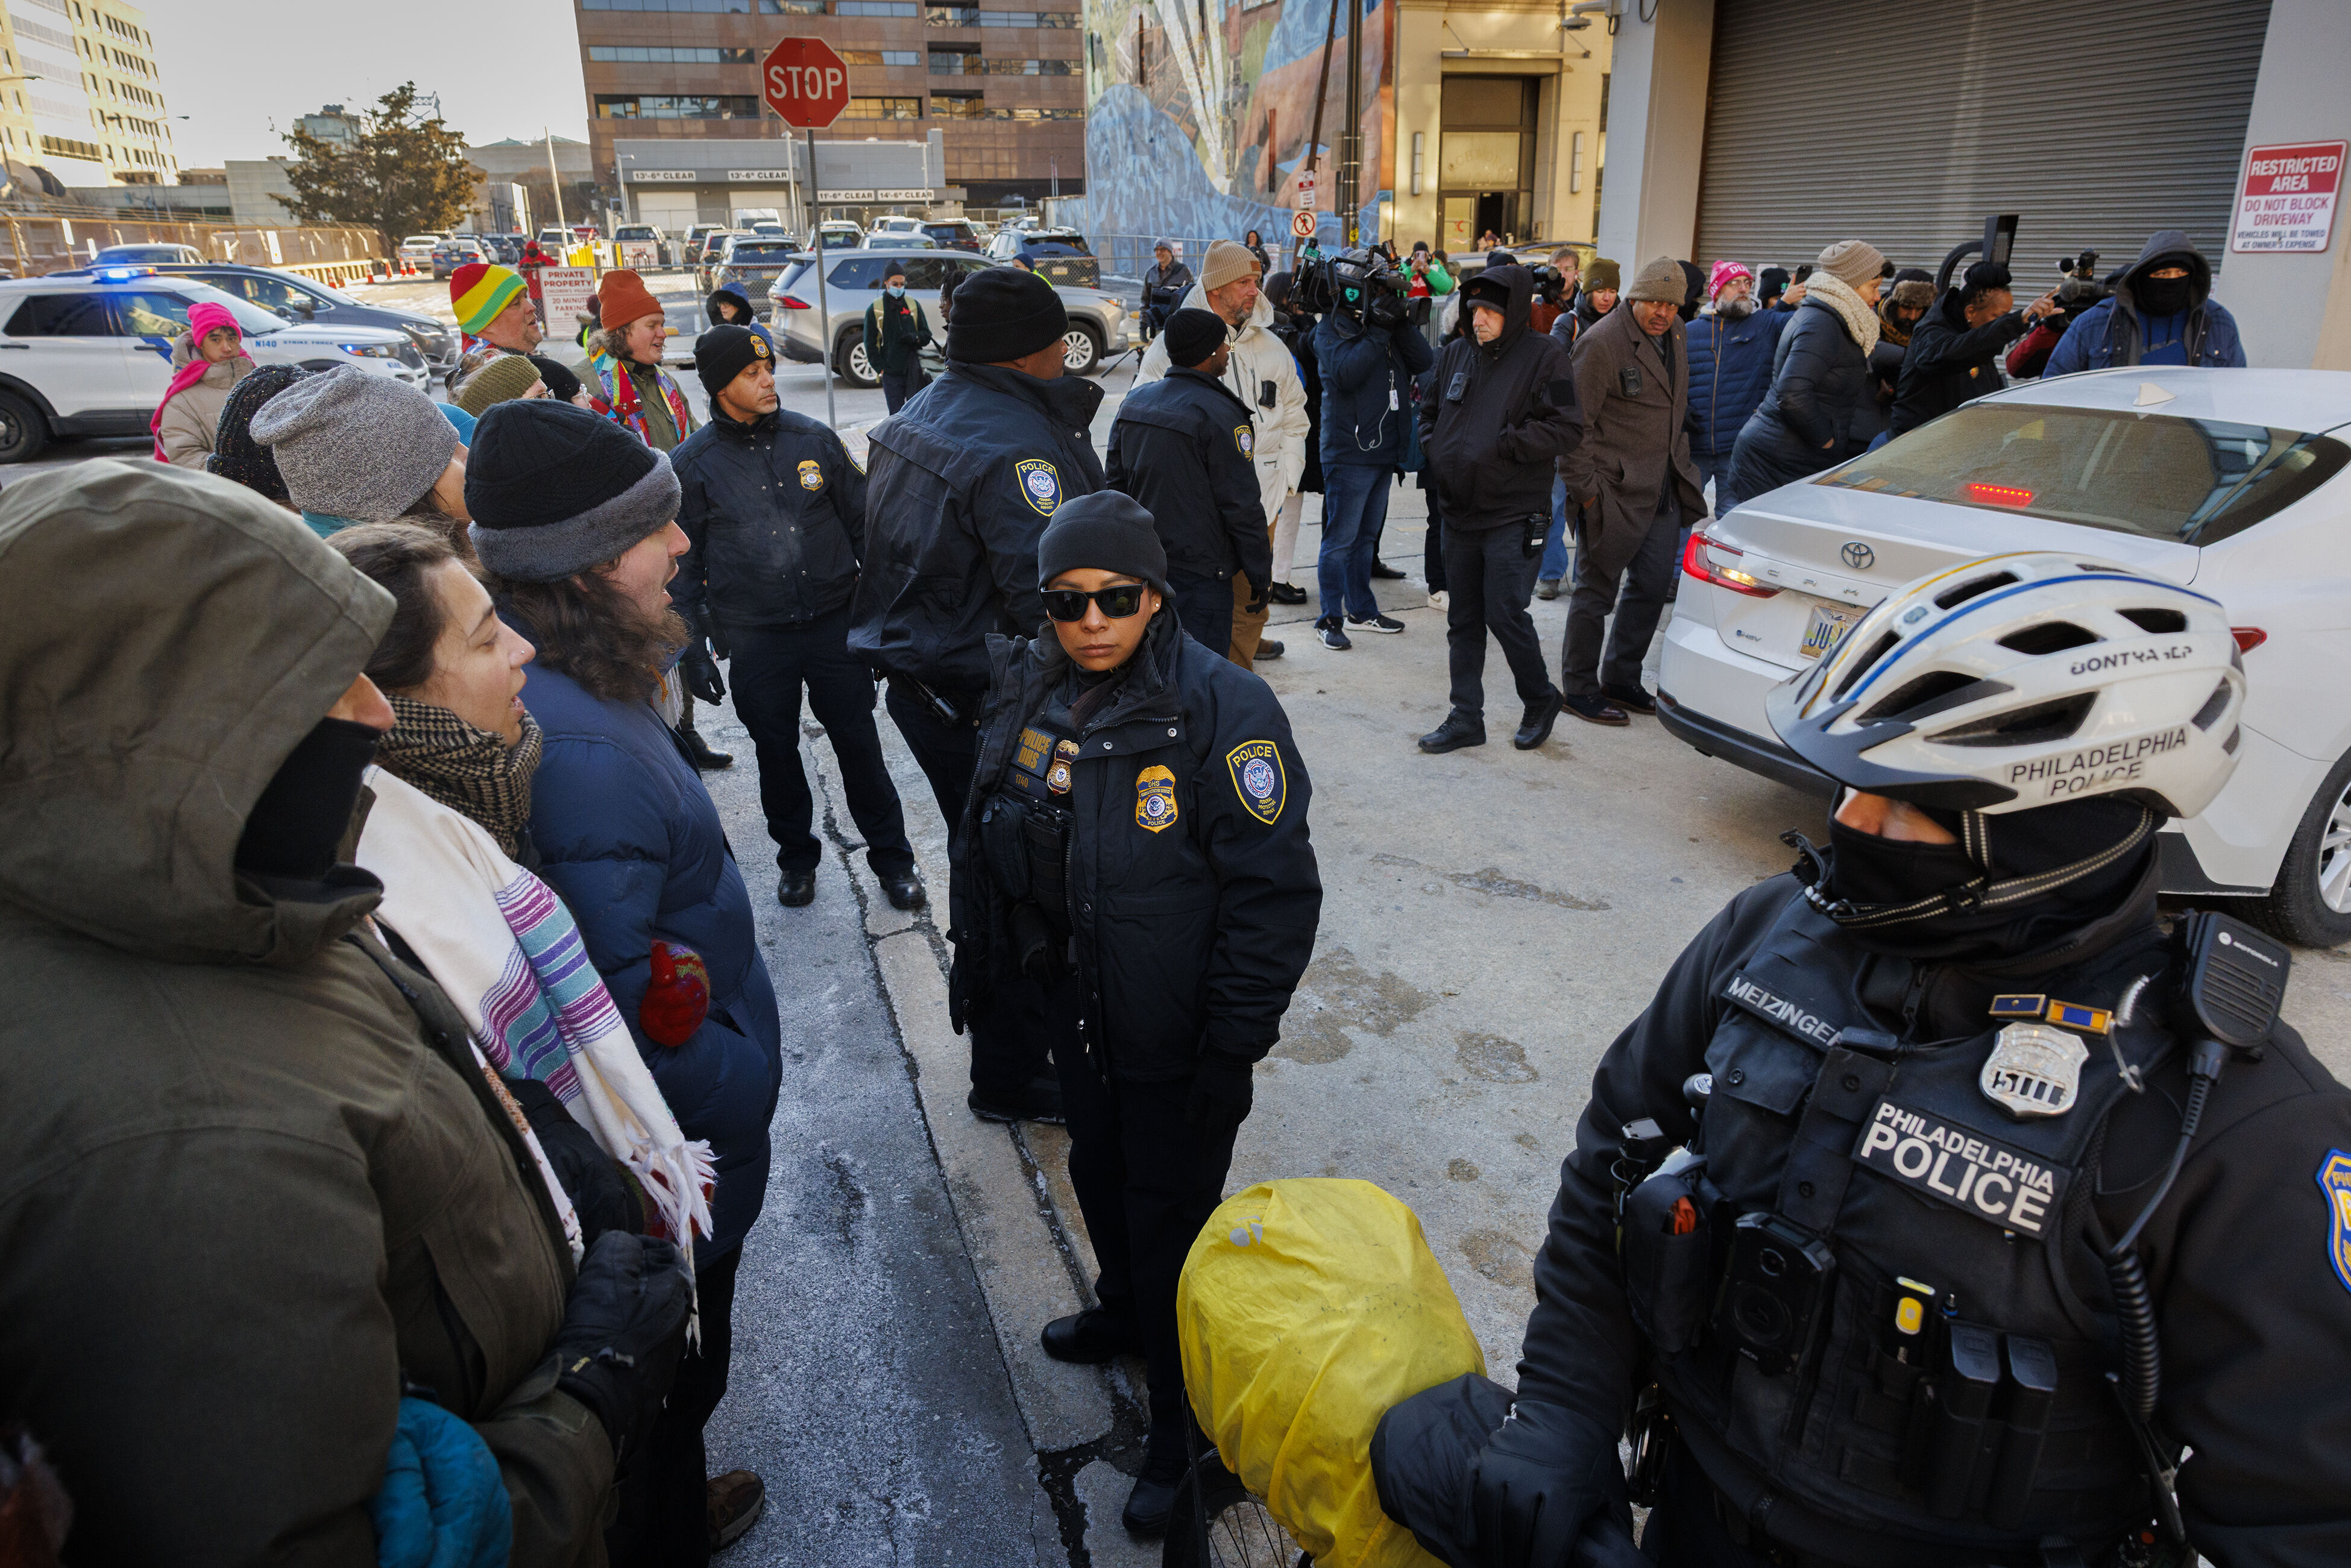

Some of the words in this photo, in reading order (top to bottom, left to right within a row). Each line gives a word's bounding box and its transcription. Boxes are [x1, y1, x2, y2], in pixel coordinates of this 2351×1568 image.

[769, 65, 843, 99] STOP
[2250, 156, 2338, 176] RESTRICTED
[2270, 175, 2309, 192] AREA
[2244, 200, 2261, 212] DO
[2264, 198, 2288, 211] NOT
[2290, 197, 2329, 210] BLOCK
[2253, 212, 2314, 226] DRIVEWAY
[2237, 230, 2269, 239] VEHICLES
[2290, 230, 2299, 238] BE
[2302, 228, 2326, 238] TOWED
[1020, 462, 1054, 475] POLICE
[1019, 728, 1051, 755] POLICE
[1018, 746, 1040, 770] DHS
[1232, 745, 1272, 768] POLICE
[2012, 728, 2186, 783] PHILADELPHIA
[1016, 773, 1028, 788] 1740
[1258, 799, 1276, 810] PROTECTIVE
[1263, 807, 1276, 816] SERVICE
[2232, 941, 2279, 968] MOTOROLA
[1875, 1102, 2054, 1195] PHILADELPHIA
[1860, 1121, 2052, 1232] POLICE
